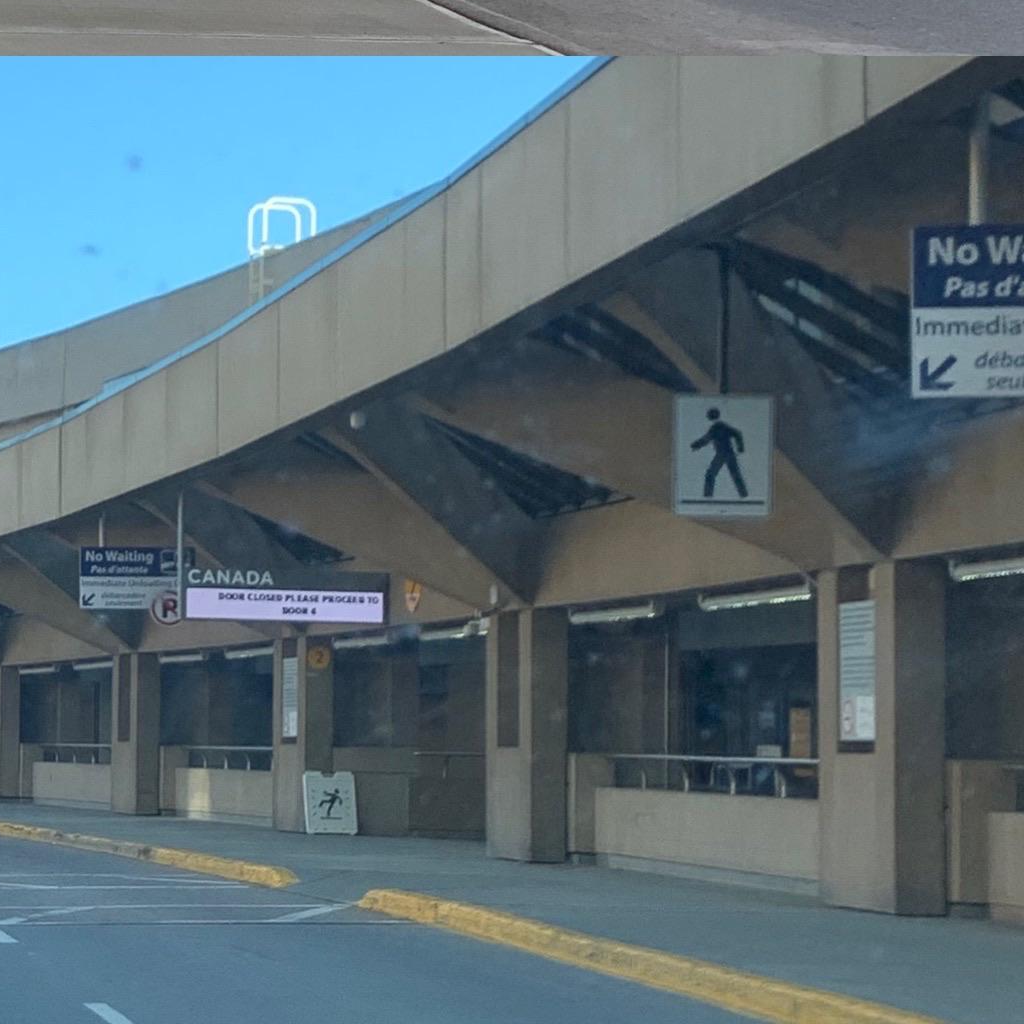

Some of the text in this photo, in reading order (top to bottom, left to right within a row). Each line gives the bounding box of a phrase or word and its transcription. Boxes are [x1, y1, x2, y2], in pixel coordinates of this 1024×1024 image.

[927, 234, 1024, 266] No W
[943, 276, 990, 299] Pas
[915, 314, 1024, 336] Immedia
[85, 549, 154, 564] No Waiting
[90, 565, 106, 574] Pas
[187, 569, 274, 585] CANADA
[218, 592, 379, 604] DOOR CLOSED PLEASE PROCEED TO
[282, 606, 308, 615] DOOR
